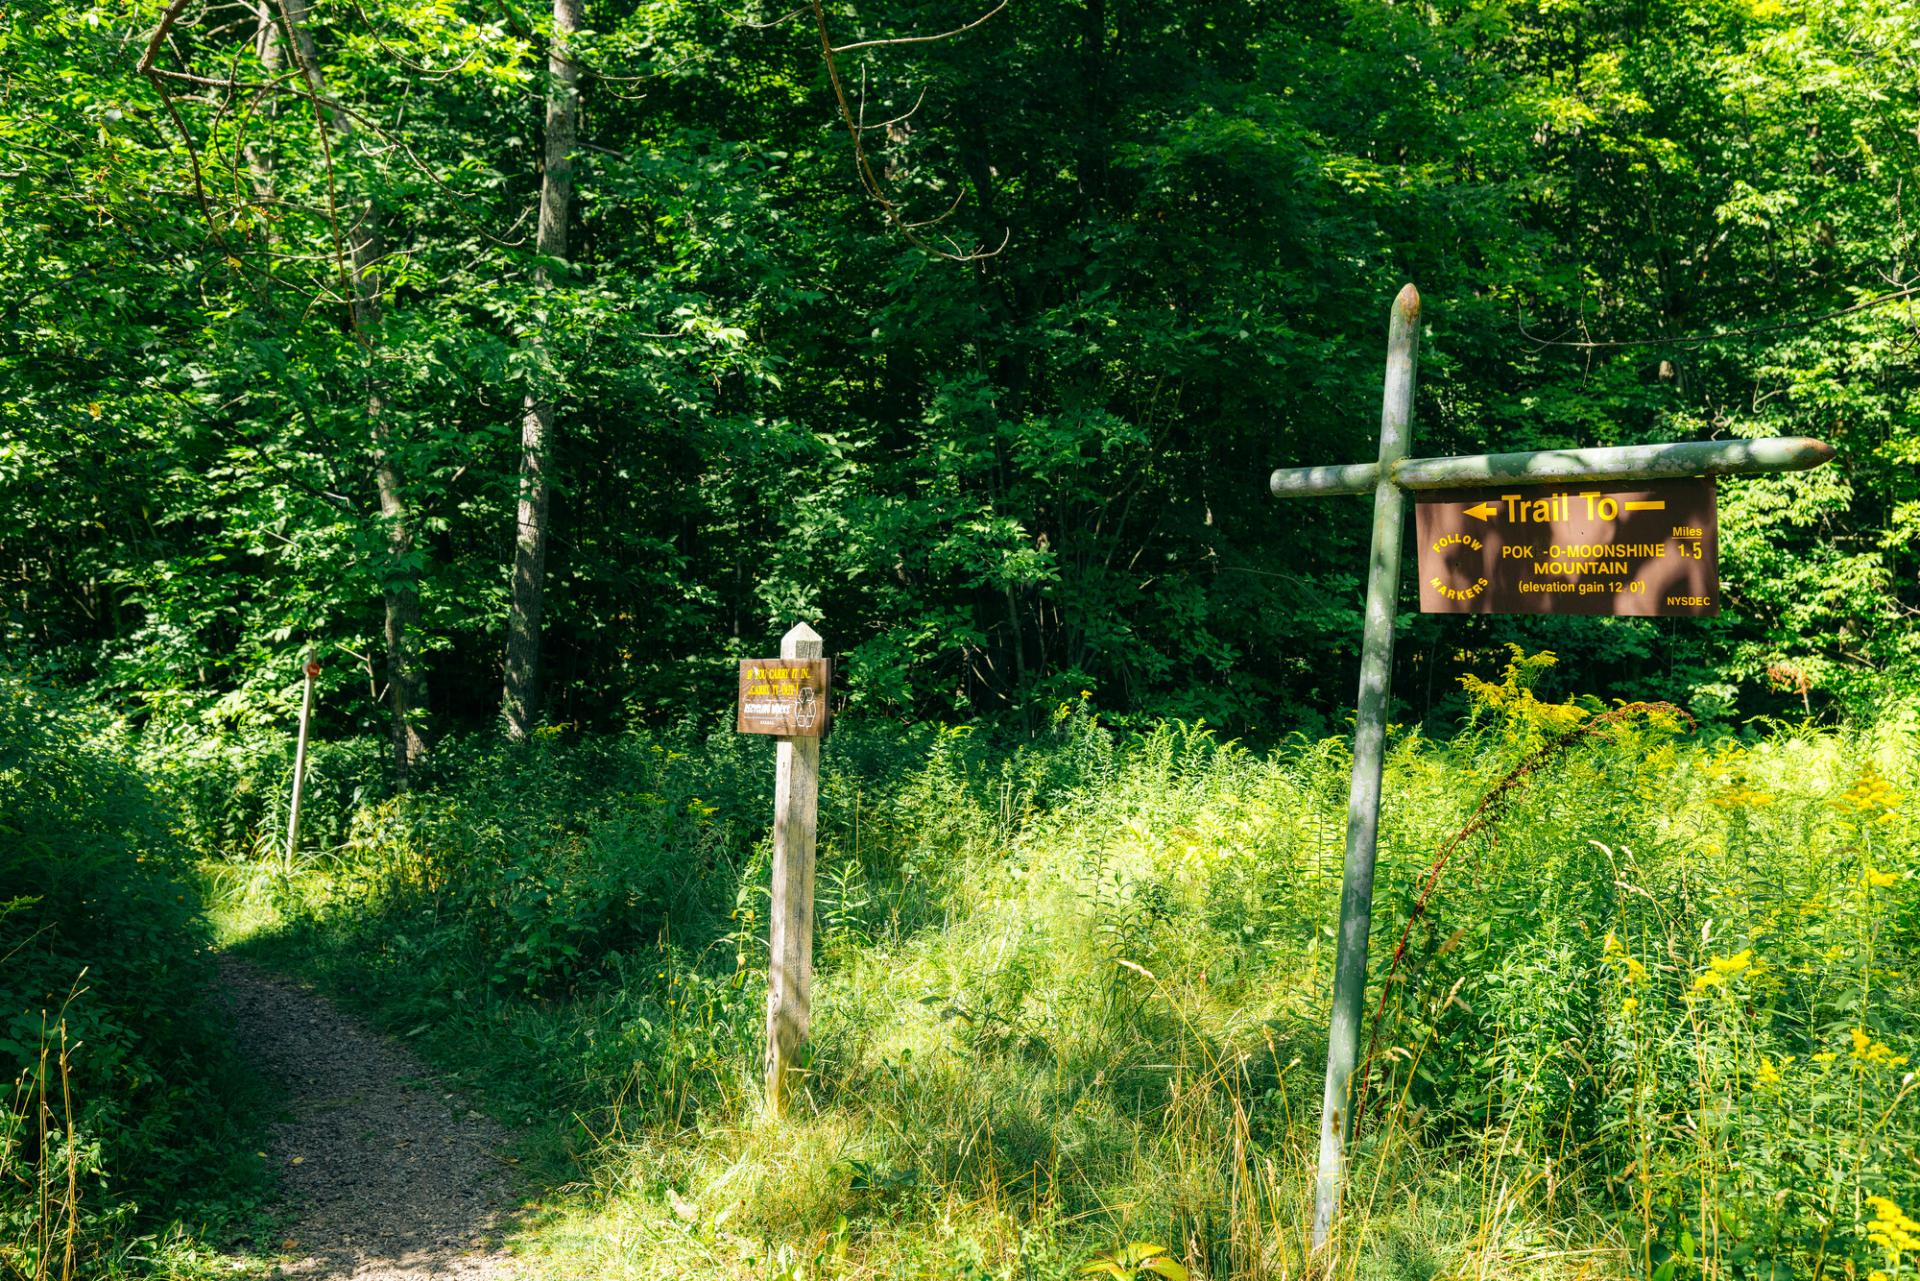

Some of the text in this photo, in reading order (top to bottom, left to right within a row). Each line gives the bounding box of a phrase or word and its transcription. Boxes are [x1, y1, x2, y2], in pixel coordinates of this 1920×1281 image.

[1501, 491, 1618, 523] Trail To
[1673, 526, 1702, 537] Miles
[1432, 533, 1483, 553] FOLLOW
[1502, 545, 1533, 559] POK
[1678, 542, 1702, 560] 1.5
[1534, 562, 1628, 575] MOUNTAIN
[1430, 577, 1488, 600] MARKERS
[1518, 580, 1575, 594] (elevation
[1579, 581, 1604, 595] gain
[1667, 596, 1711, 606] NYSDEC
